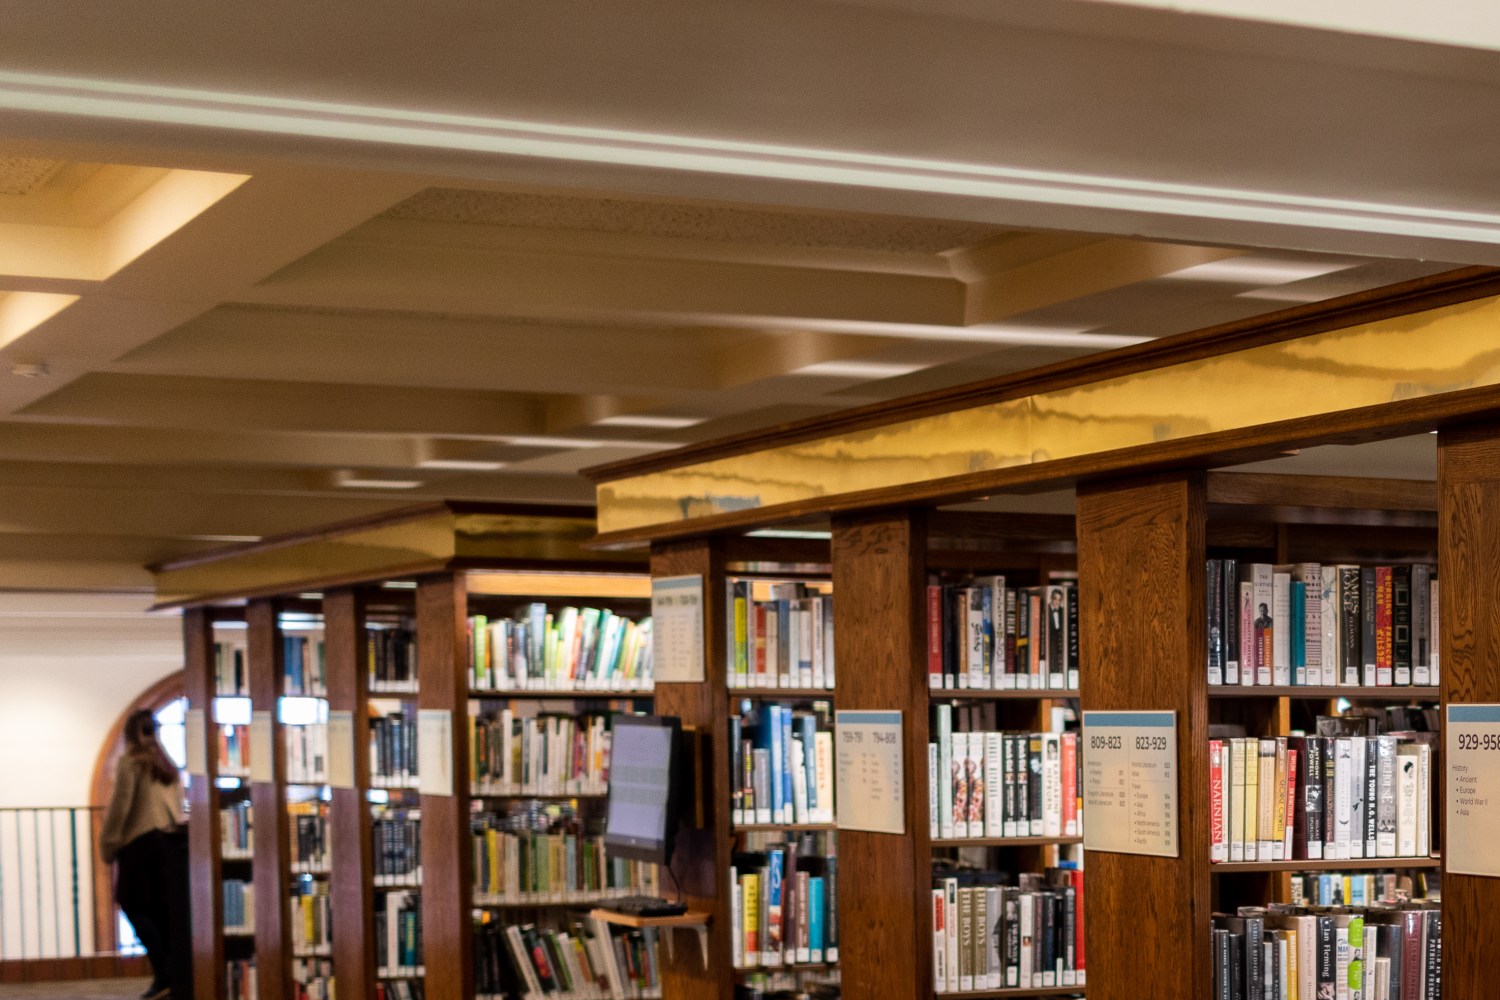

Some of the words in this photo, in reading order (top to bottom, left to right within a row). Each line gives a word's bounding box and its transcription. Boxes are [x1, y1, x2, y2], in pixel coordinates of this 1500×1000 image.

[1350, 569, 1359, 613] JAMES
[1091, 736, 1121, 749] 809-823
[1136, 737, 1166, 749] 823-929
[1452, 765, 1468, 773] History
[1213, 780, 1222, 840] NARNIAN
[962, 893, 970, 913] THE
[963, 918, 971, 946] BOYS
[1322, 945, 1330, 977] Fleming
